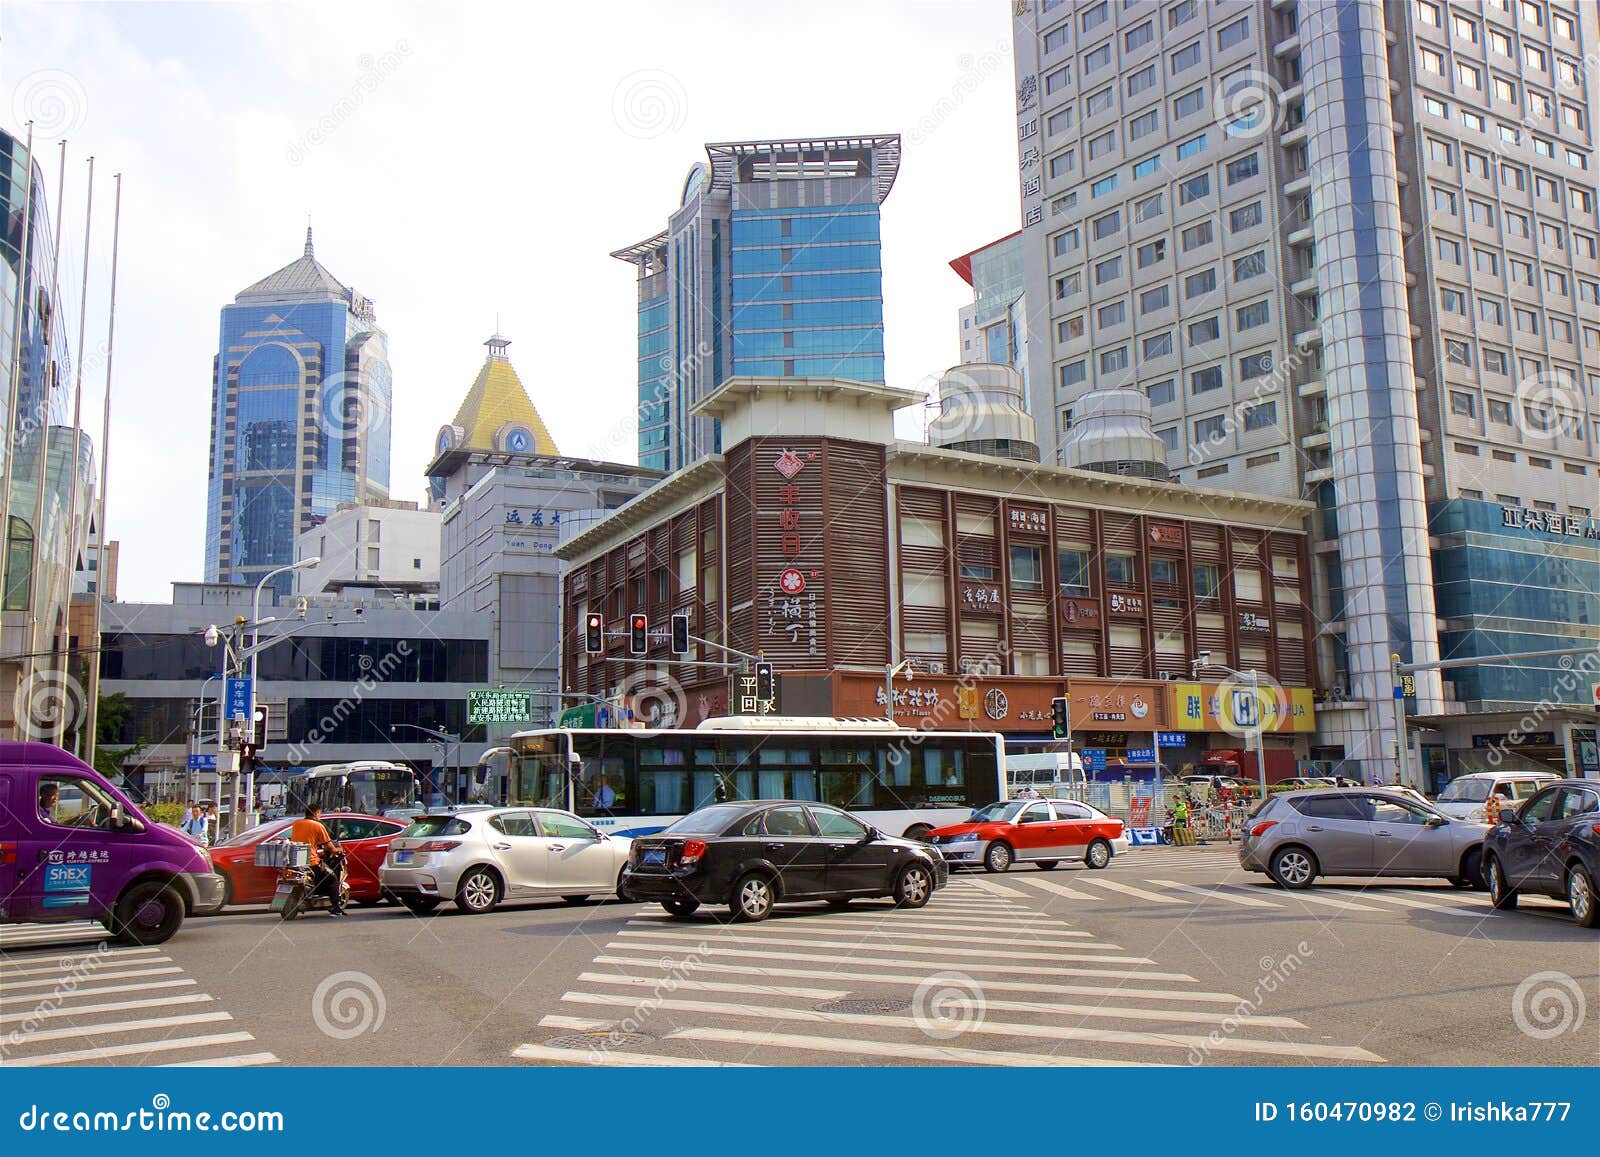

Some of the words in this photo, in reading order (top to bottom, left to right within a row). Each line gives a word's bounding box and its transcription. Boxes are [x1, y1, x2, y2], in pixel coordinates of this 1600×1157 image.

[1019, 118, 1042, 229] 亚朵酒店
[780, 484, 800, 553] 丰收日
[1503, 505, 1581, 537] 亚朵酒店
[533, 541, 553, 550] Dong
[50, 868, 88, 880] ShEX
